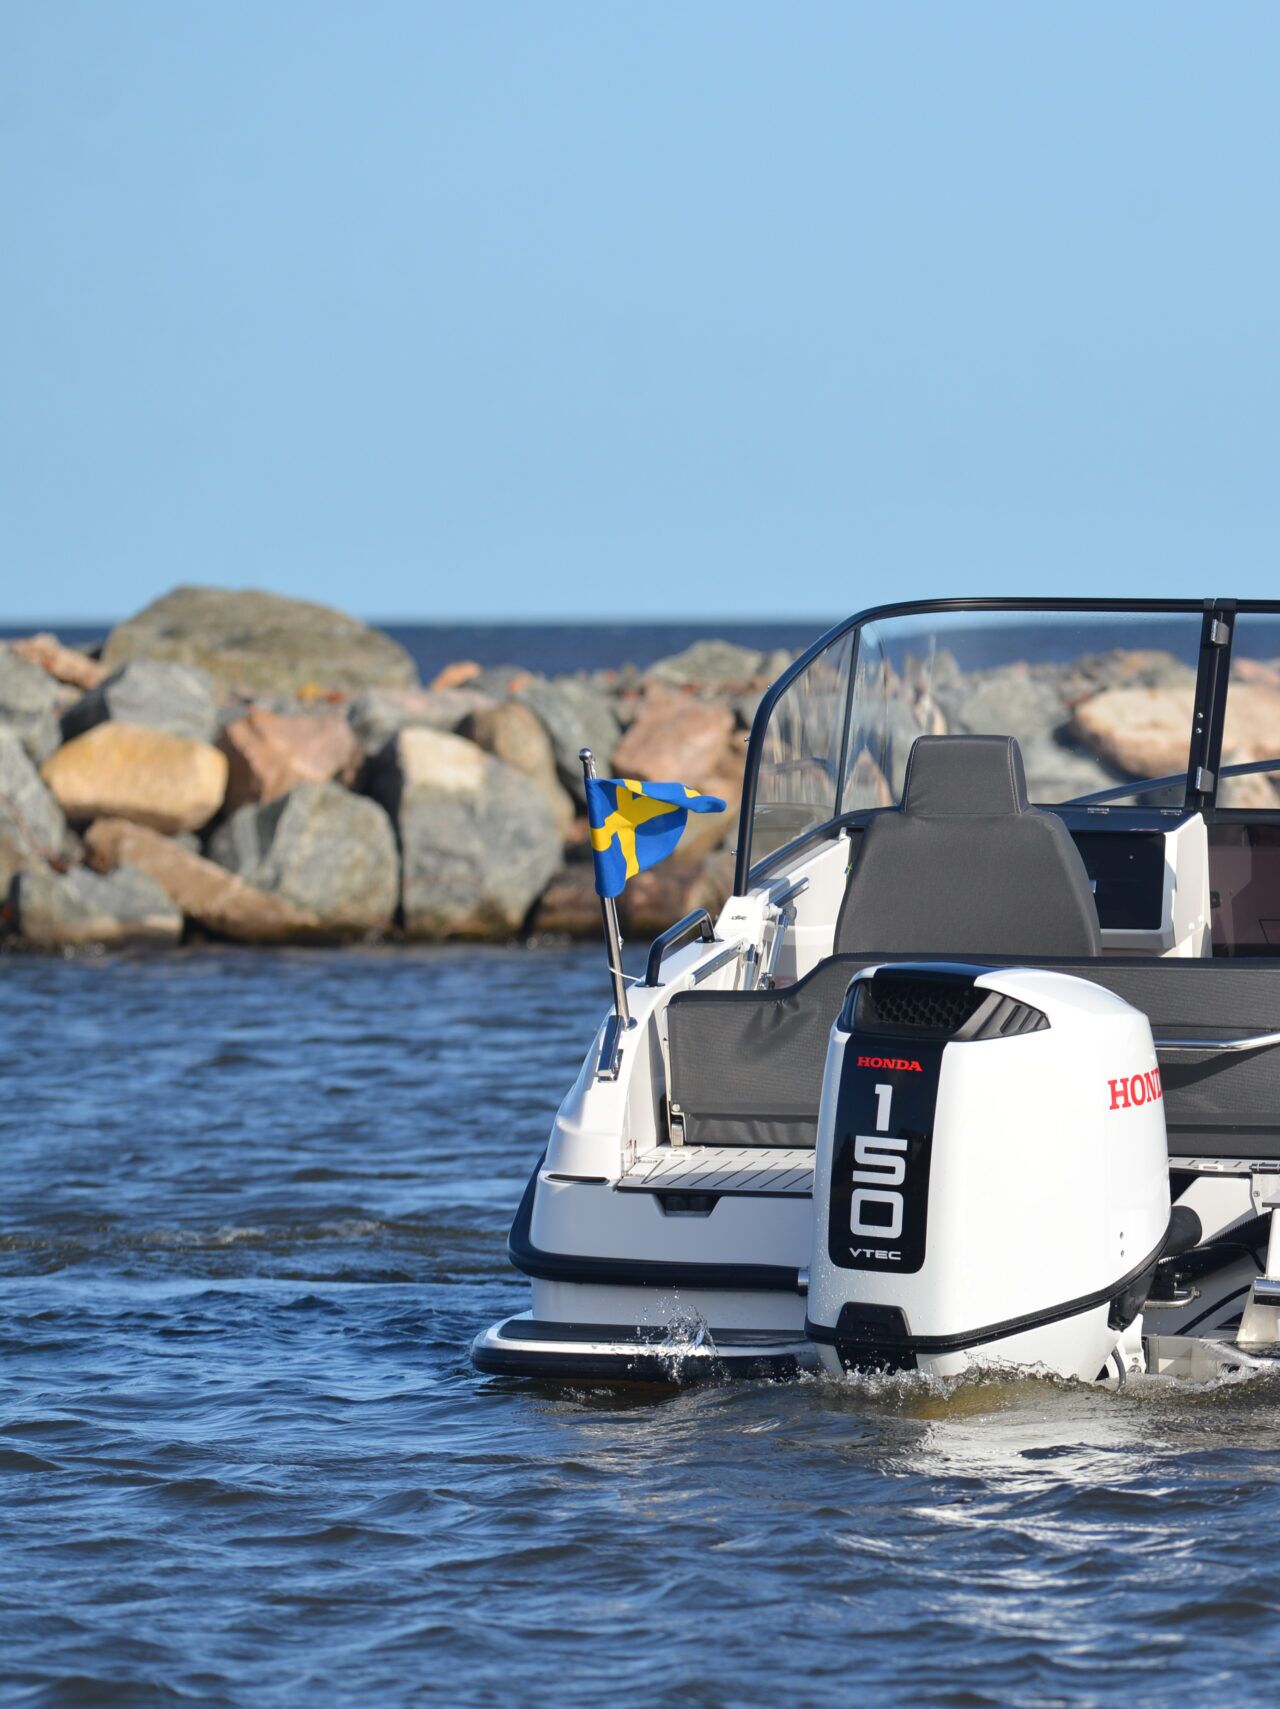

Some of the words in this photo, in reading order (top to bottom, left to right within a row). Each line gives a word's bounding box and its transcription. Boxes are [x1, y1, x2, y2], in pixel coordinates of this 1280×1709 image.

[857, 1056, 923, 1072] HONDA
[850, 1084, 908, 1239] 150
[849, 1247, 902, 1260] VTEC
